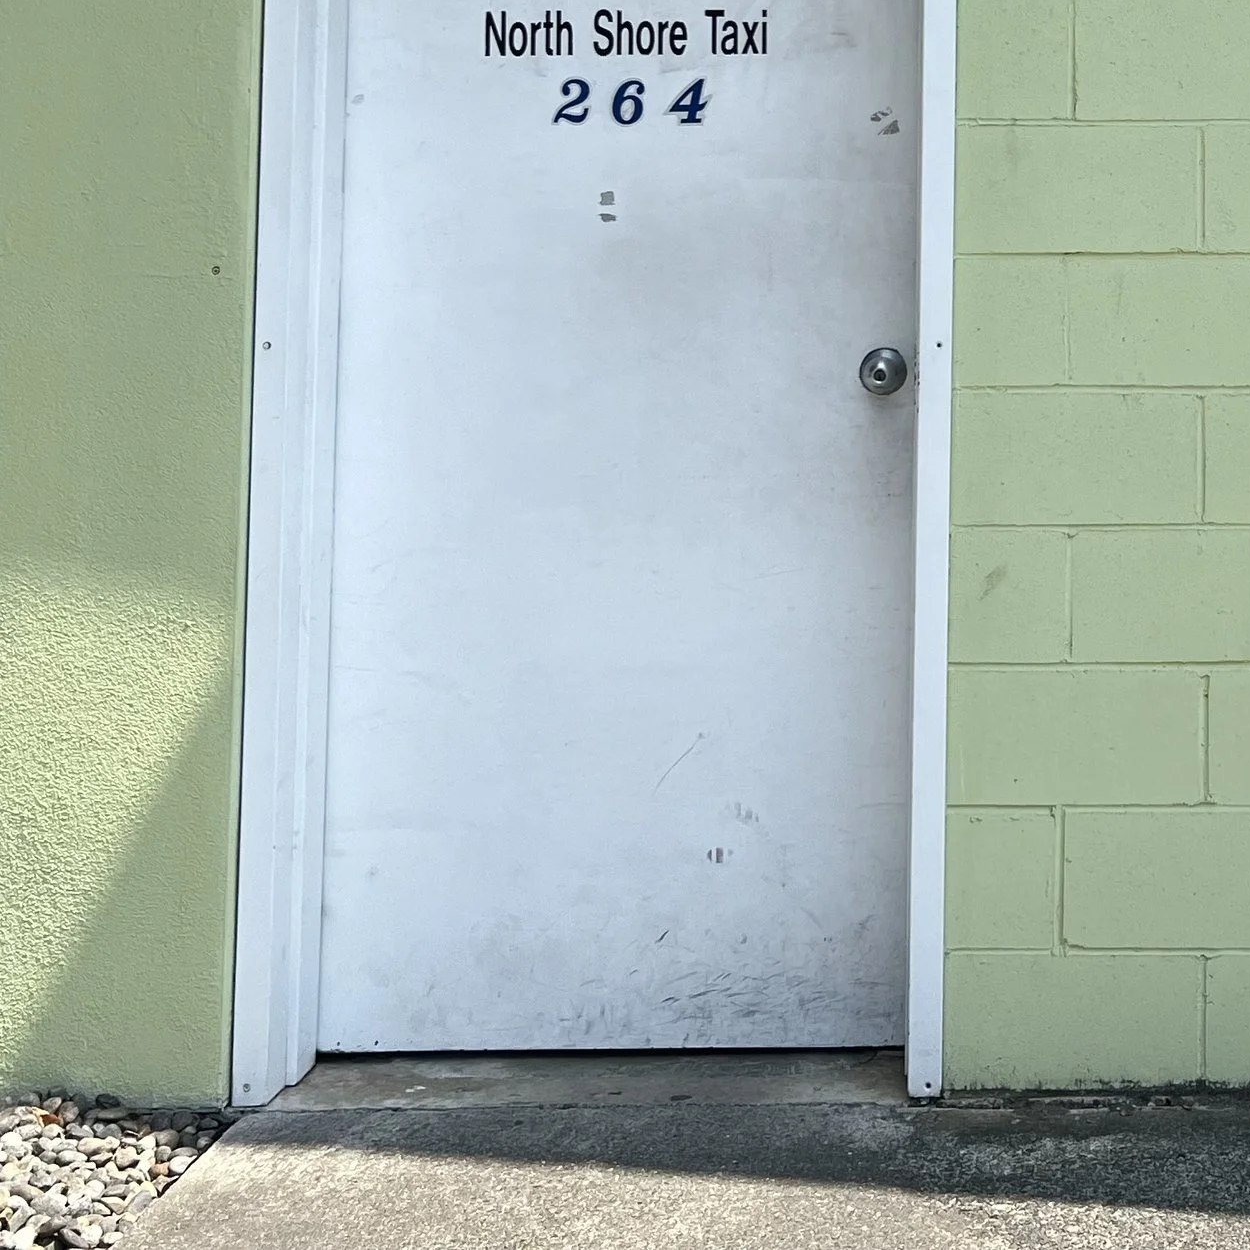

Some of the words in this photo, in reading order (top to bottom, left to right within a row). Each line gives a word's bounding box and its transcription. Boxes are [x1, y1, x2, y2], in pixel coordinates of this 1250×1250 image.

[484, 10, 574, 57] North
[593, 8, 688, 56] Shore
[705, 9, 768, 55] Taxi
